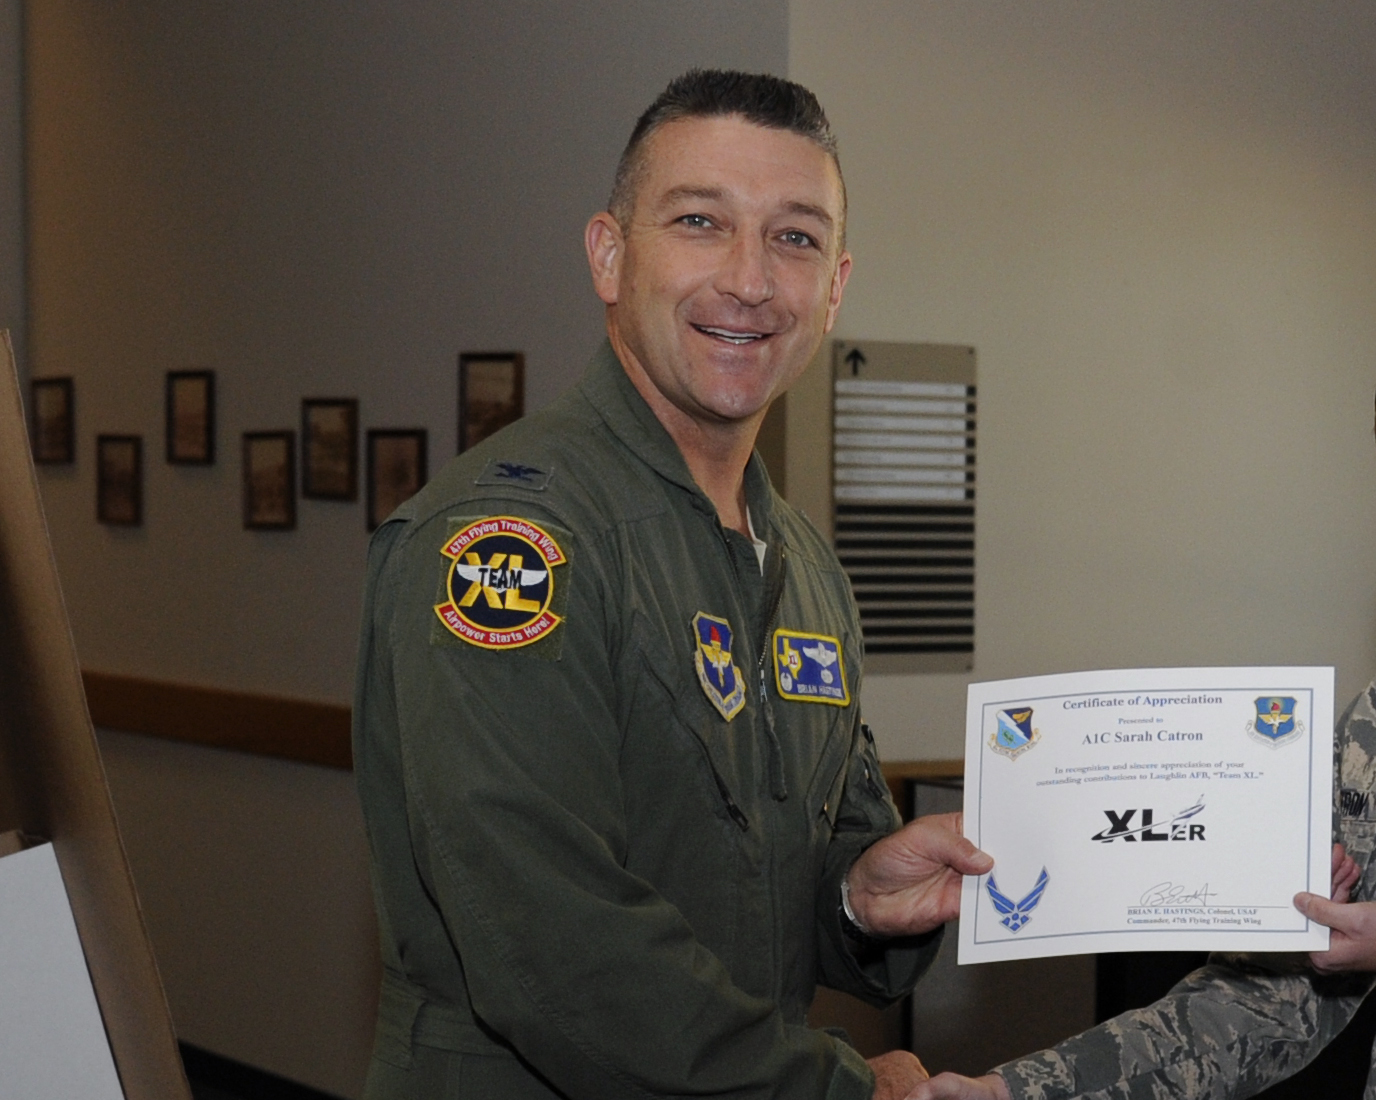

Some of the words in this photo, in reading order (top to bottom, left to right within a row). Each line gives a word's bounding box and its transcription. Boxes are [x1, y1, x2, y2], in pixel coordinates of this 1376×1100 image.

[449, 534, 471, 554] 47th
[468, 522, 499, 538] Flying
[501, 520, 540, 542] Training
[537, 536, 559, 561] Wing
[458, 552, 540, 613] XL
[478, 568, 523, 589] TEAM
[444, 610, 486, 641] Airpower
[489, 632, 523, 643] Starts
[523, 616, 551, 638] Here!
[1063, 697, 1125, 710] Certificate
[1128, 696, 1141, 706] of
[1143, 694, 1223, 707] Appreciation
[1118, 717, 1154, 725] Presented
[1082, 732, 1111, 745] A1C
[1114, 731, 1153, 743] Sarah
[1157, 730, 1203, 742] Catron
[1065, 764, 1110, 774] recognition
[1129, 762, 1158, 770] sincere
[1161, 761, 1212, 771] appreciation
[1226, 762, 1245, 770] your
[1150, 772, 1187, 781] Laughlin
[1189, 917, 1211, 925] Flying
[1212, 917, 1241, 925] Training
[1243, 917, 1262, 925] Wing
